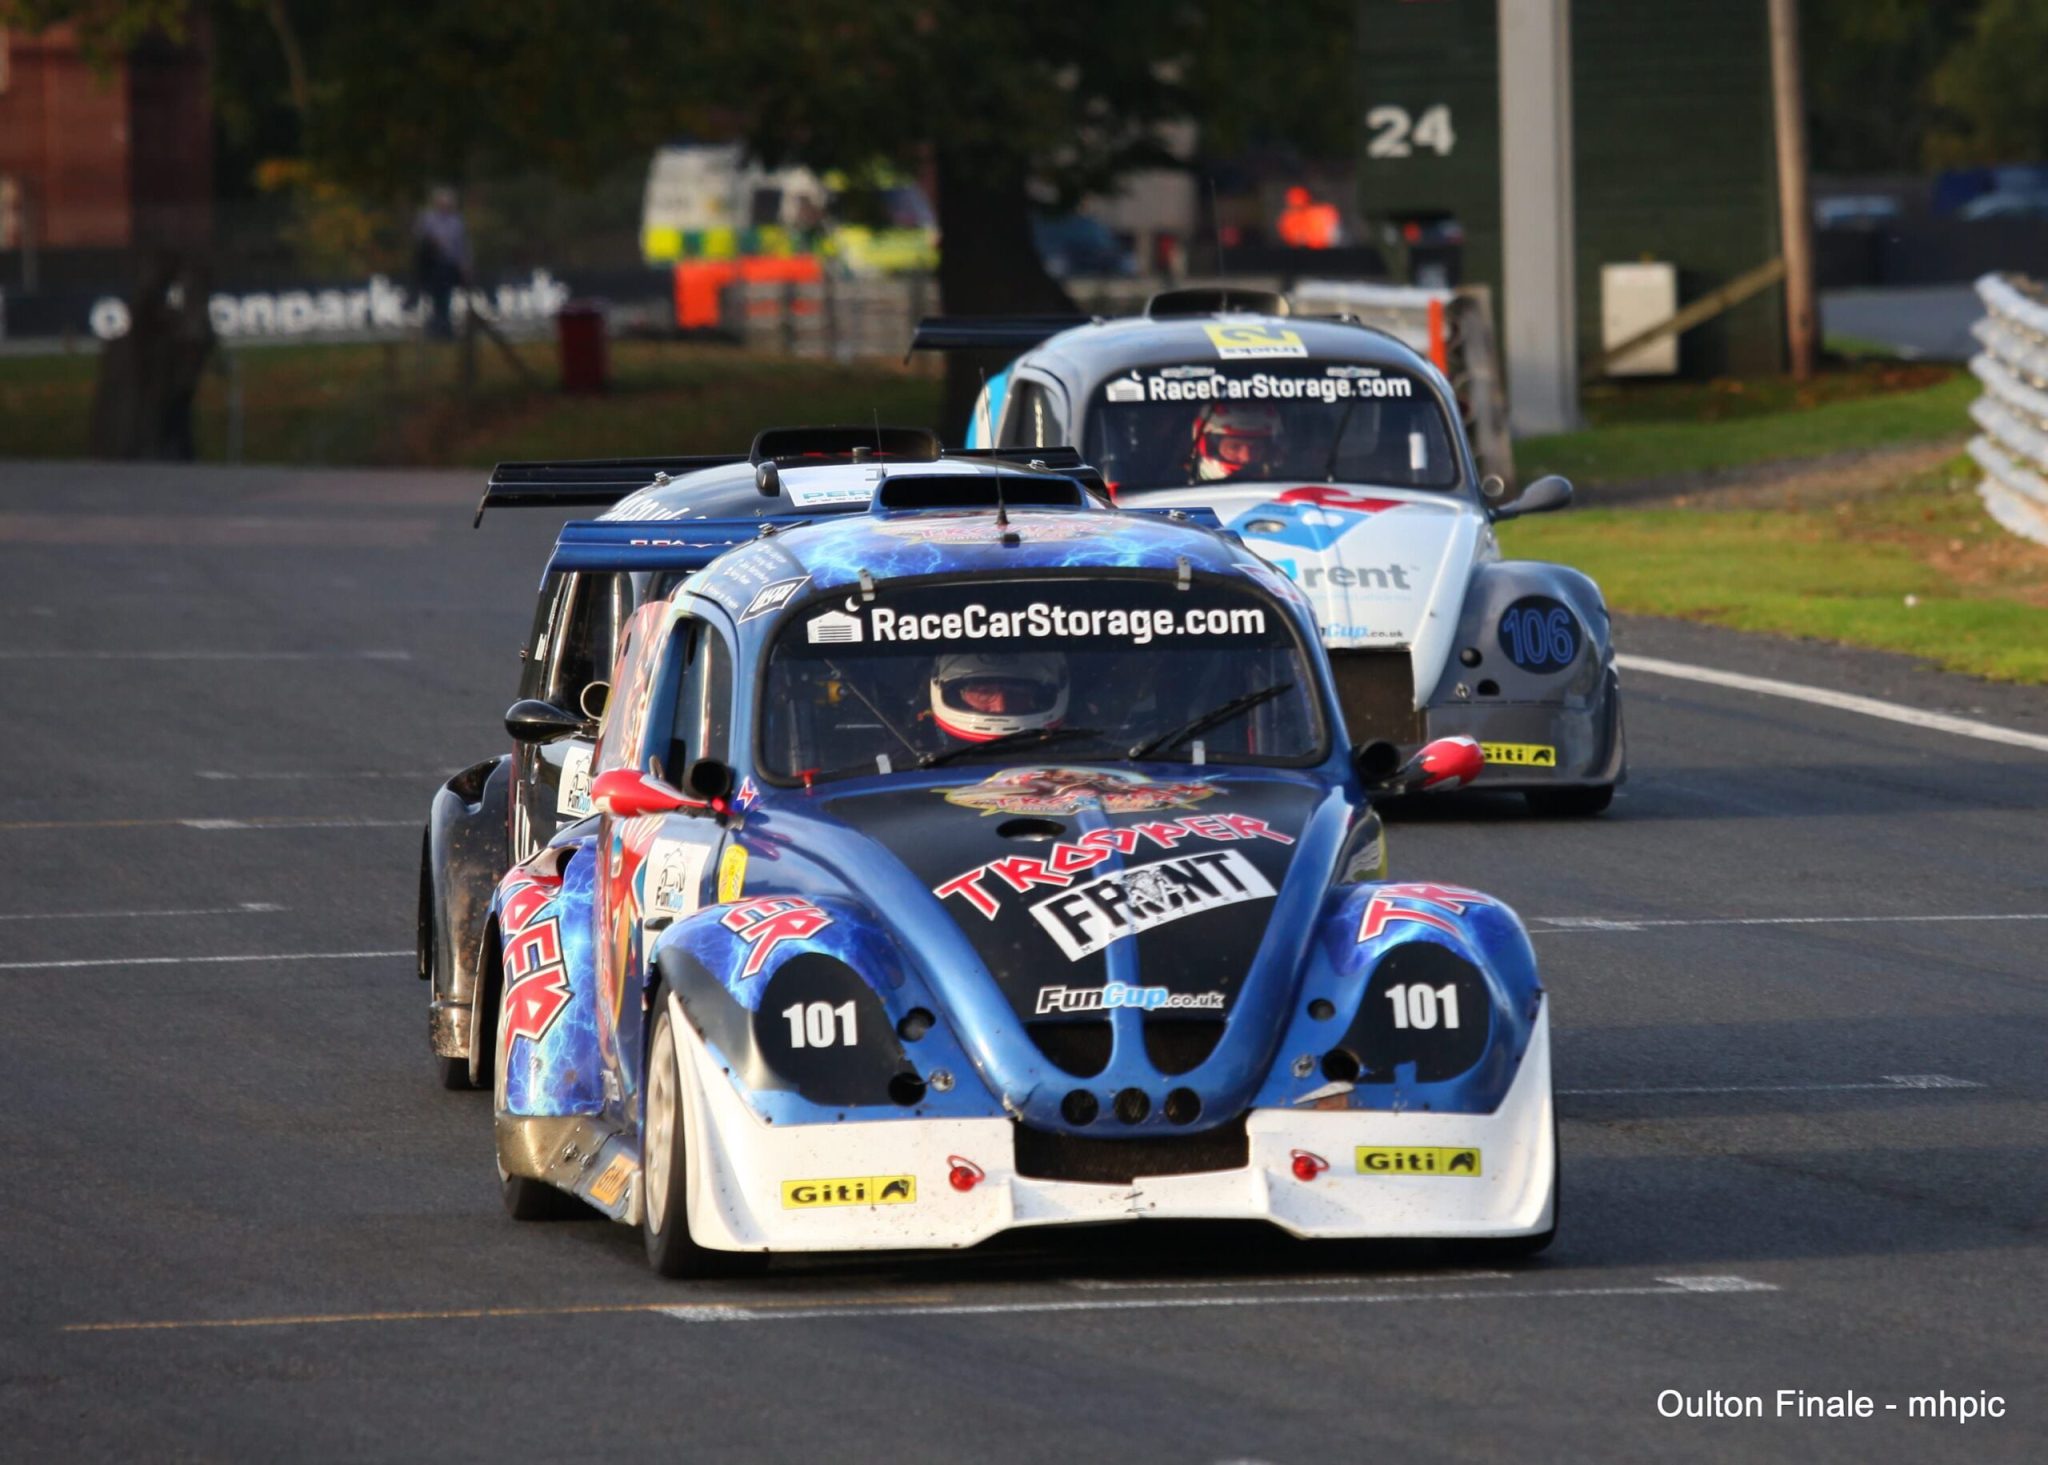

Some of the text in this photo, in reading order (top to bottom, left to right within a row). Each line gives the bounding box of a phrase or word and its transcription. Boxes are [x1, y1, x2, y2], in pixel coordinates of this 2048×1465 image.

[1366, 105, 1455, 157] 24
[1150, 374, 1412, 403] RaceCarStorage.com
[872, 602, 1266, 645] RaceCarStorage.com
[1503, 608, 1573, 665] 106
[933, 813, 1295, 921] TROOPER
[1036, 982, 1226, 1014] FunCup.co.uk
[1385, 983, 1459, 1029] 101
[782, 1000, 857, 1049] 101
[1364, 1152, 1435, 1171] Giti
[791, 1183, 865, 1205] Giti
